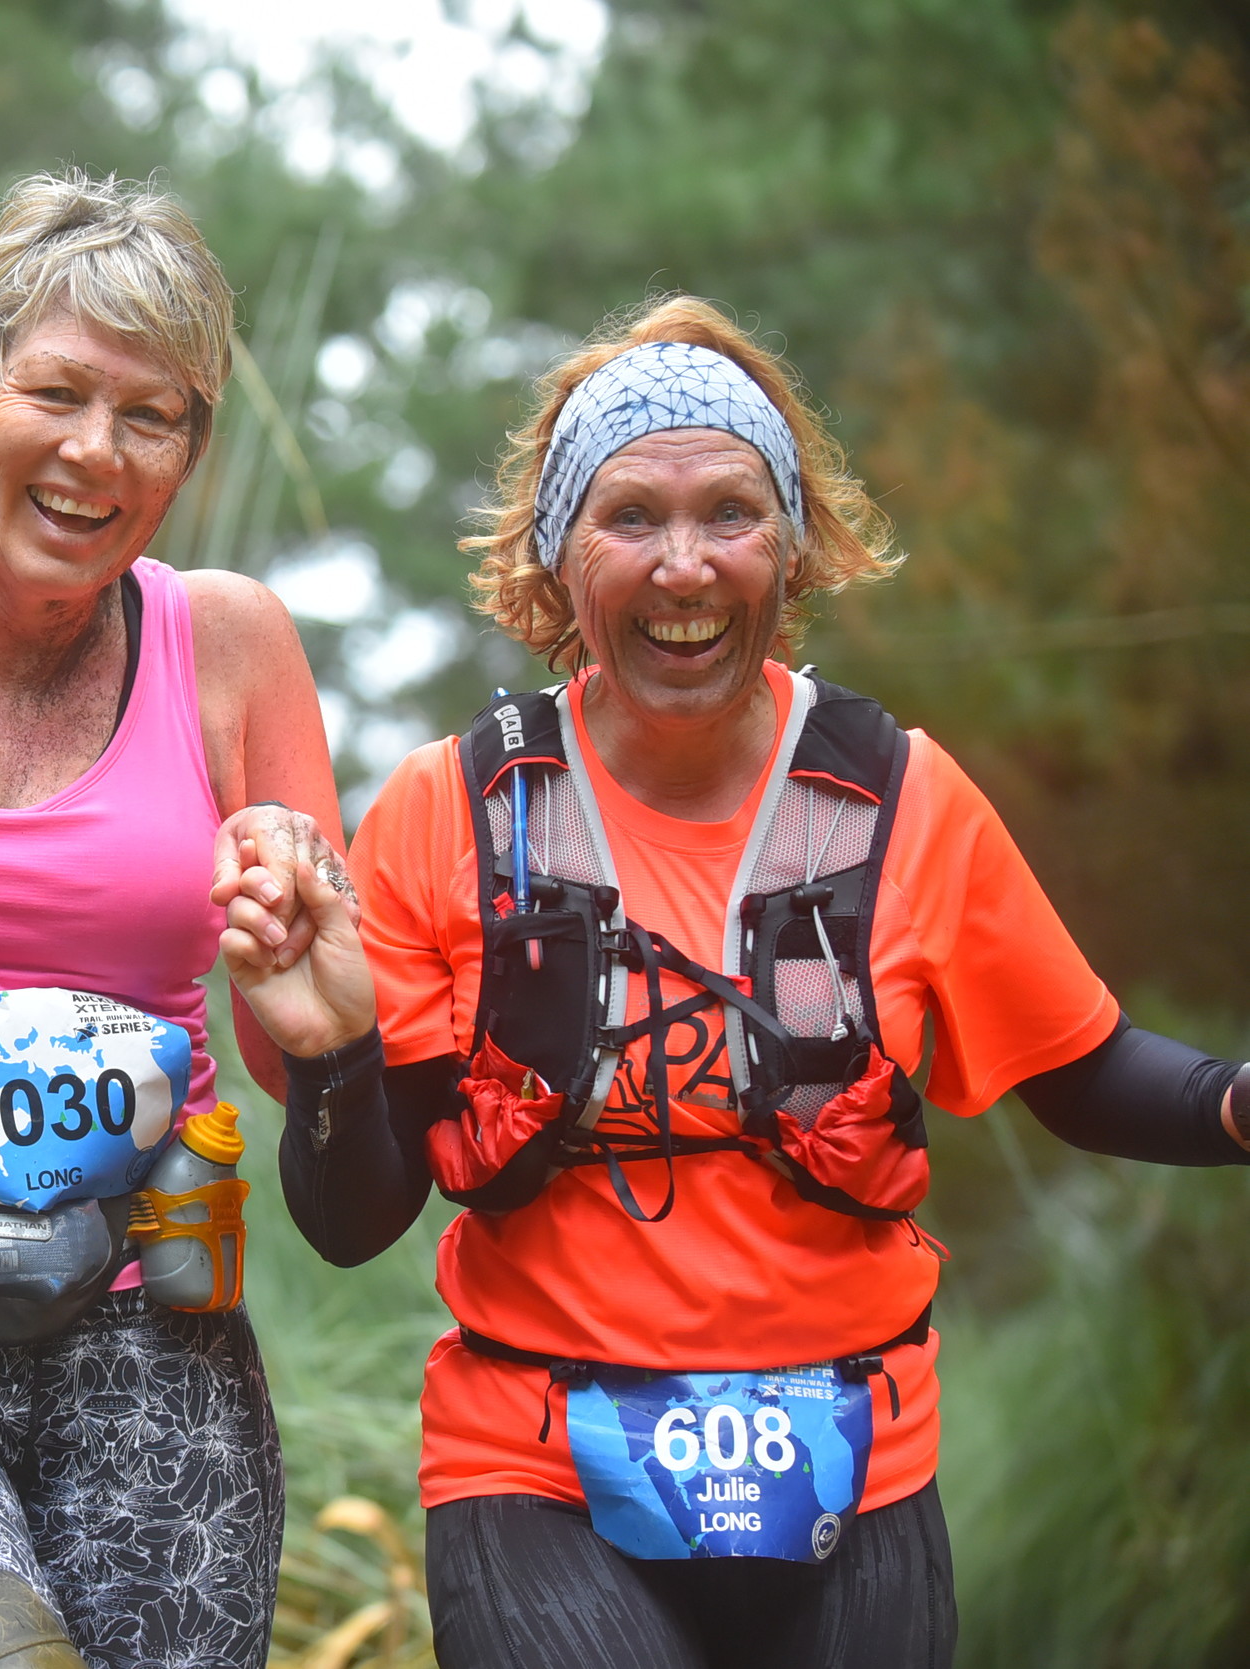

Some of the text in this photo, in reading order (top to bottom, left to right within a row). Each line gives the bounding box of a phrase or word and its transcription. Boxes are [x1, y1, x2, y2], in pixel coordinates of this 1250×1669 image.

[497, 706, 521, 748] LAB
[72, 993, 123, 1005] AUCKL
[79, 1015, 103, 1023] TRAIL
[101, 1021, 152, 1035] SERIES
[26, 1166, 83, 1191] LONG
[764, 1374, 833, 1388] TRAIL RUN/WALK
[784, 1385, 835, 1400] SERIES
[653, 1404, 796, 1473] 608
[696, 1476, 761, 1502] Julie
[699, 1511, 762, 1533] LONG
